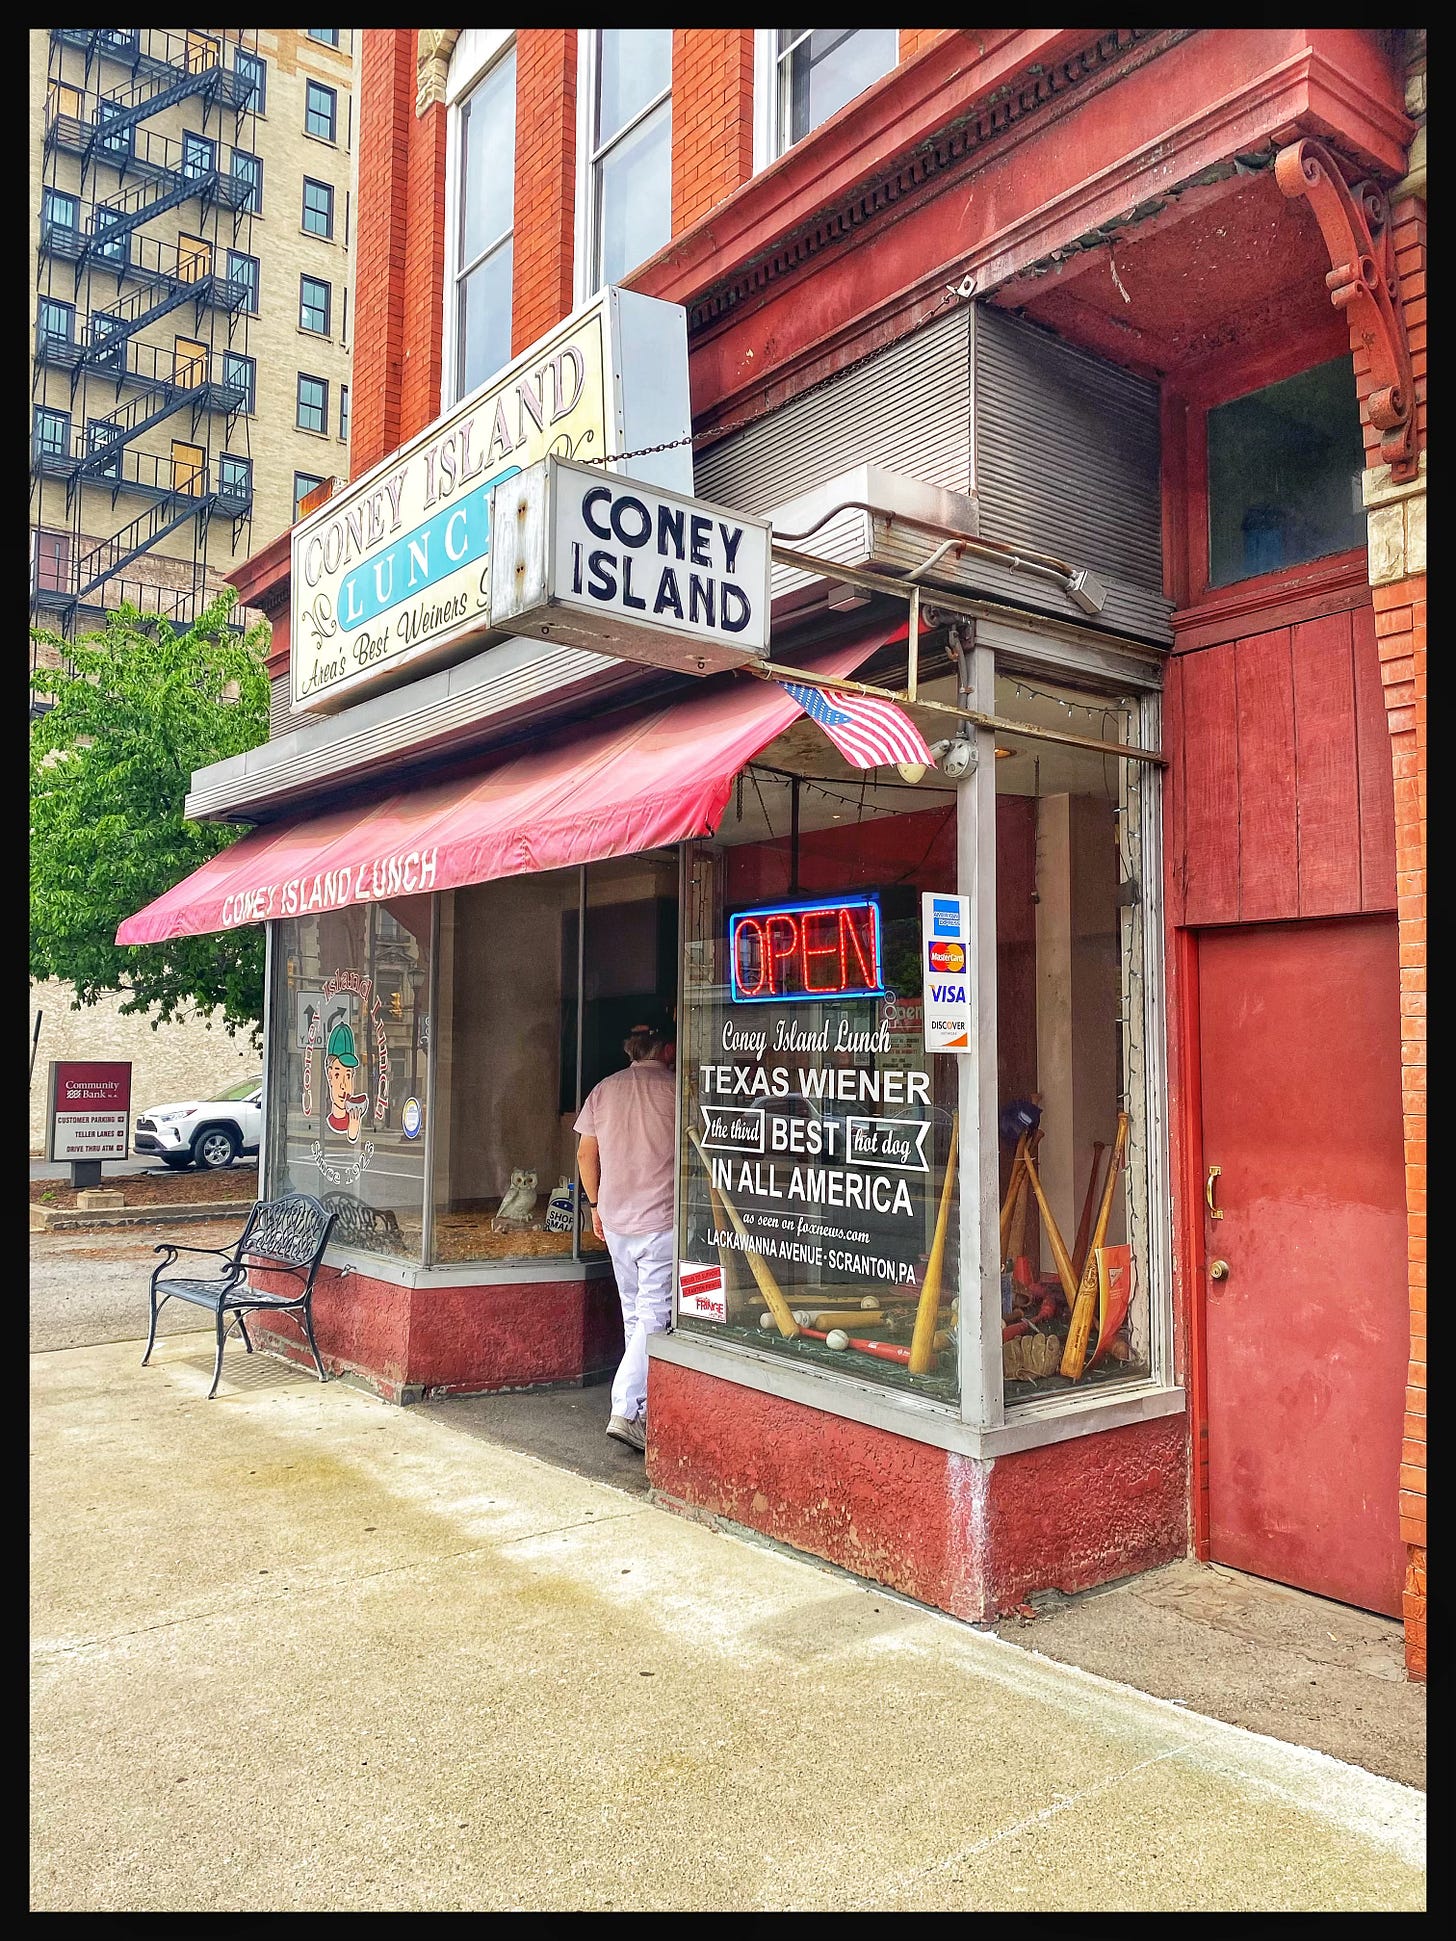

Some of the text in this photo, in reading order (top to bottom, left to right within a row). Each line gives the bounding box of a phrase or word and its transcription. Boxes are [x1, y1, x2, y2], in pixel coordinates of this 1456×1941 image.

[305, 346, 585, 587] CONEY ISLAND
[582, 486, 743, 573] CONEY
[571, 542, 751, 632] ISLAND
[302, 592, 467, 694] Area's Best Weiners
[222, 847, 438, 926] CONEY ISLAND LUNCH
[735, 904, 877, 995] OPEN
[931, 953, 964, 962] MasterCard
[928, 985, 966, 1003] VISA
[302, 968, 389, 1120] Coney Island Lunch
[723, 1020, 891, 1061] Coney Island Lunch
[932, 1021, 965, 1030] DISCOVER
[65, 1081, 119, 1091] Community
[83, 1090, 106, 1098] Bank
[701, 1066, 932, 1105] TEXAS WIENER
[711, 1117, 760, 1141] the third
[772, 1118, 840, 1156] BEST
[854, 1130, 911, 1164] hot dog
[311, 1141, 374, 1184] Since 1923
[712, 1158, 913, 1217] IN ALL AMERICA
[707, 1229, 777, 1257] LACKAWANNA
[743, 1213, 870, 1243] as seen on foxnews.com
[696, 1299, 723, 1314] FRINGE
